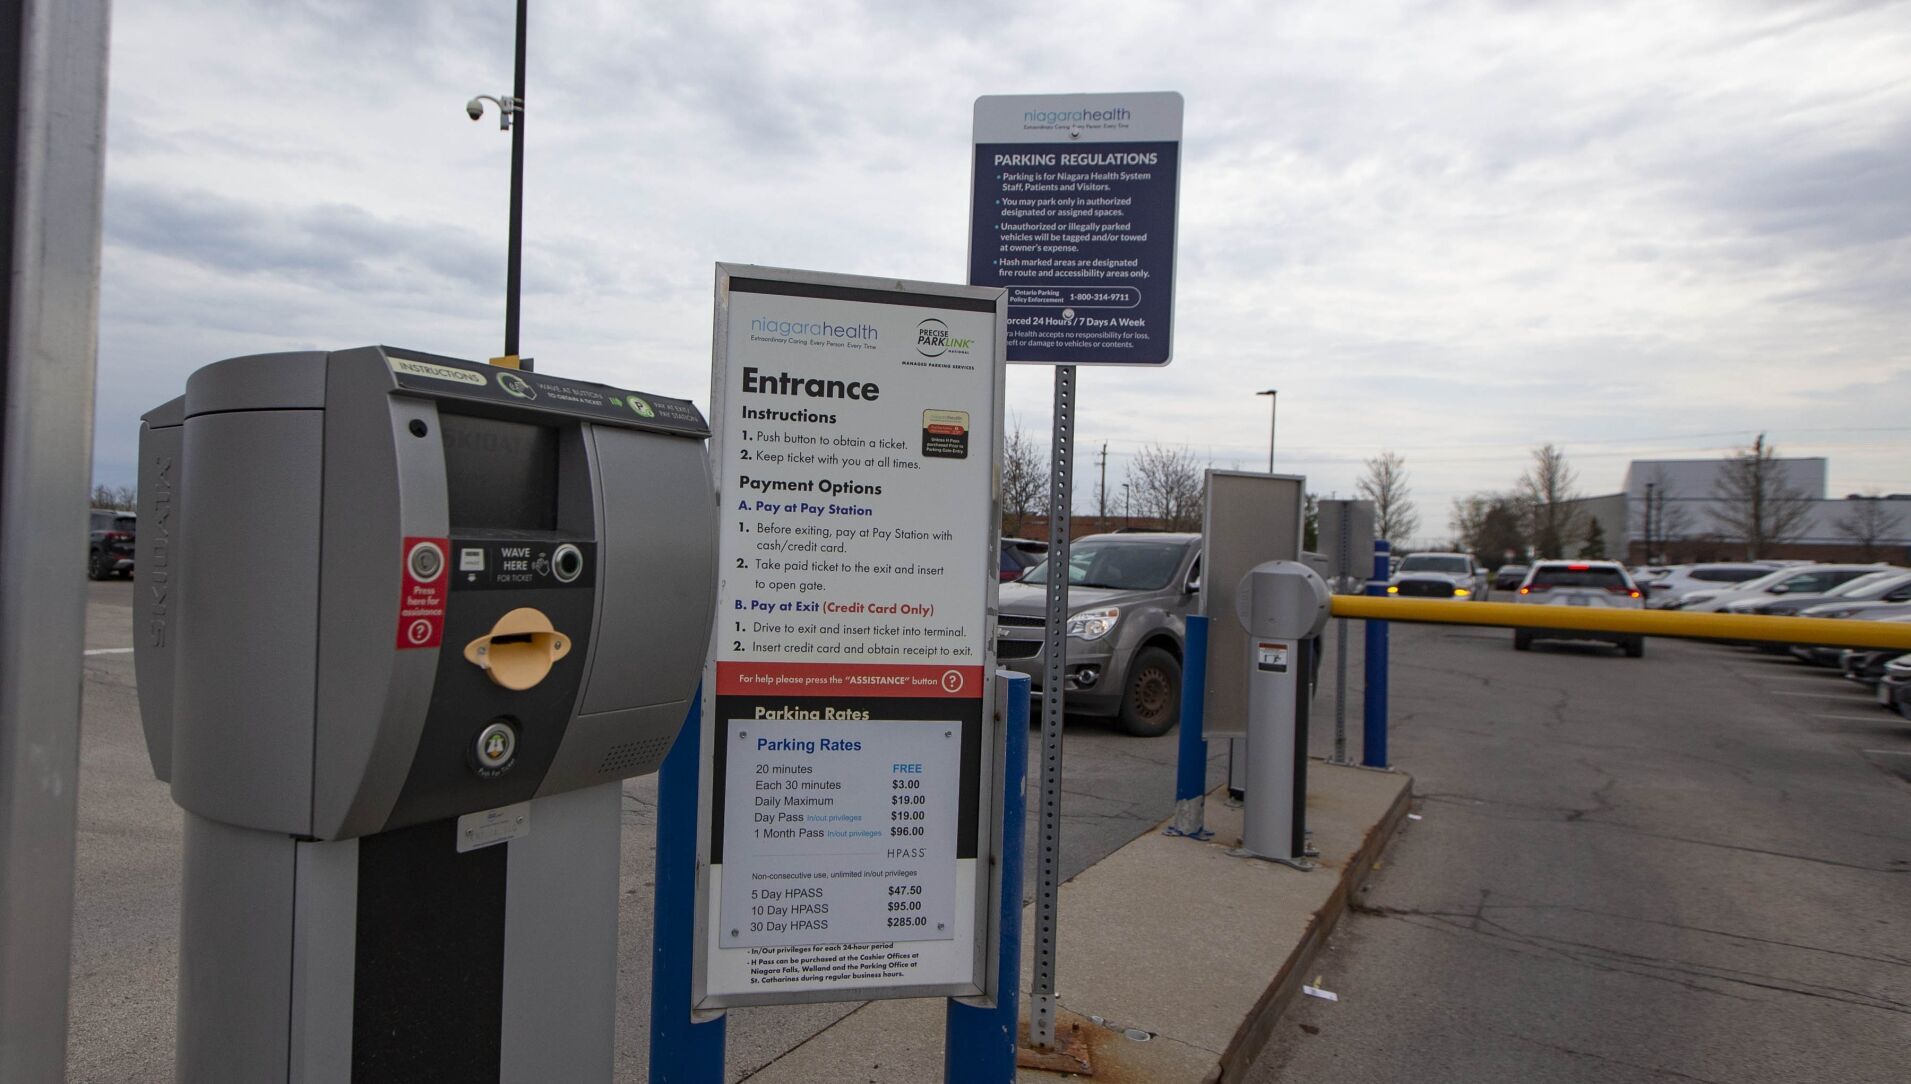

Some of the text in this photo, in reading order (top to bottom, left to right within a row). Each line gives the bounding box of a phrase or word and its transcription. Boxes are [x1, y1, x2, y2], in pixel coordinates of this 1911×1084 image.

[1024, 108, 1130, 124] niagarahealth
[995, 153, 1157, 166] PARKING REGULATIONS
[1003, 172, 1032, 181] Parking
[1035, 172, 1041, 180] is
[1043, 172, 1055, 180] for
[1057, 172, 1089, 181] Niagara
[1121, 172, 1151, 181] System
[1003, 183, 1110, 192] Staff, Patients and Visitors.
[1019, 199, 1035, 207] may
[1037, 197, 1056, 207] park
[1058, 197, 1075, 207] only
[1077, 197, 1084, 205] in
[1086, 197, 1131, 205] authorized
[1001, 208, 1045, 218] designated
[1057, 208, 1093, 218] assigned
[1095, 209, 1123, 218] spaces.
[1001, 222, 1056, 231] Unauthorized
[1068, 222, 1100, 232] illegally
[1102, 222, 1130, 232] parked
[1001, 233, 1147, 243] vehicles will be tagged and/or towed
[1000, 244, 1079, 253] at owner's expense.
[1000, 258, 1020, 266] Hash
[1022, 258, 1052, 266] marked
[1093, 258, 1137, 268] designated
[999, 269, 1013, 277] fire
[1038, 269, 1053, 277] and
[1055, 269, 1104, 279] accessibility
[1130, 270, 1150, 279] only.
[1070, 293, 1129, 301] 1-800-314-9711
[1006, 317, 1031, 326] orced
[1045, 318, 1071, 326] Hours
[1080, 318, 1085, 326] 7
[1087, 318, 1107, 328] Days
[1109, 318, 1117, 326] A
[1119, 318, 1145, 326] Week
[751, 318, 878, 340] niagarahealth
[919, 329, 948, 337] PRECISE
[401, 363, 479, 383] INSTRUCTIONS
[743, 367, 879, 401] Entrance
[742, 406, 836, 424] Instructions
[742, 430, 908, 449] 1. Push button to obtain a ticket.
[740, 450, 920, 470] 2. Keep ticket with you at all times.
[740, 476, 882, 497] Payment Options
[738, 501, 872, 516] A. Pay at Pay Station
[501, 548, 530, 557] WAVE
[504, 561, 527, 570] HERE
[512, 574, 532, 582] TICKET
[413, 587, 435, 595] Press
[407, 596, 439, 606] here for
[402, 607, 442, 616] assistance
[735, 600, 934, 617] B. Pay at Exit (Credit Card Only)
[740, 675, 752, 683] For
[755, 675, 773, 685] help
[776, 675, 803, 685] please
[805, 677, 827, 686] press
[830, 676, 842, 684] the
[912, 677, 937, 685] button
[825, 707, 869, 721] Rates
[757, 738, 861, 753] Parking Rates
[756, 765, 813, 774] 20 minutes
[893, 764, 922, 773] FREE
[756, 780, 841, 790] Each 30 minutes
[893, 779, 920, 790] $3.00
[755, 797, 833, 808] Daily Maximum
[892, 795, 925, 805] $19.00
[754, 813, 775, 824] Day
[779, 813, 804, 822] Pass
[829, 814, 862, 823] privileges
[891, 811, 925, 821] $19.00
[755, 829, 759, 838] 1
[763, 829, 795, 838] Month
[799, 829, 824, 837] Pass
[849, 830, 882, 838] privileges
[891, 827, 924, 837] $96.00
[752, 888, 823, 901] 5 Day HPASS
[888, 886, 922, 896] $47.50
[752, 904, 828, 917] 10 Day HPASS
[888, 901, 921, 911] $95.00
[750, 920, 828, 933] 30 Day HPASS
[887, 917, 926, 927] $285.00
